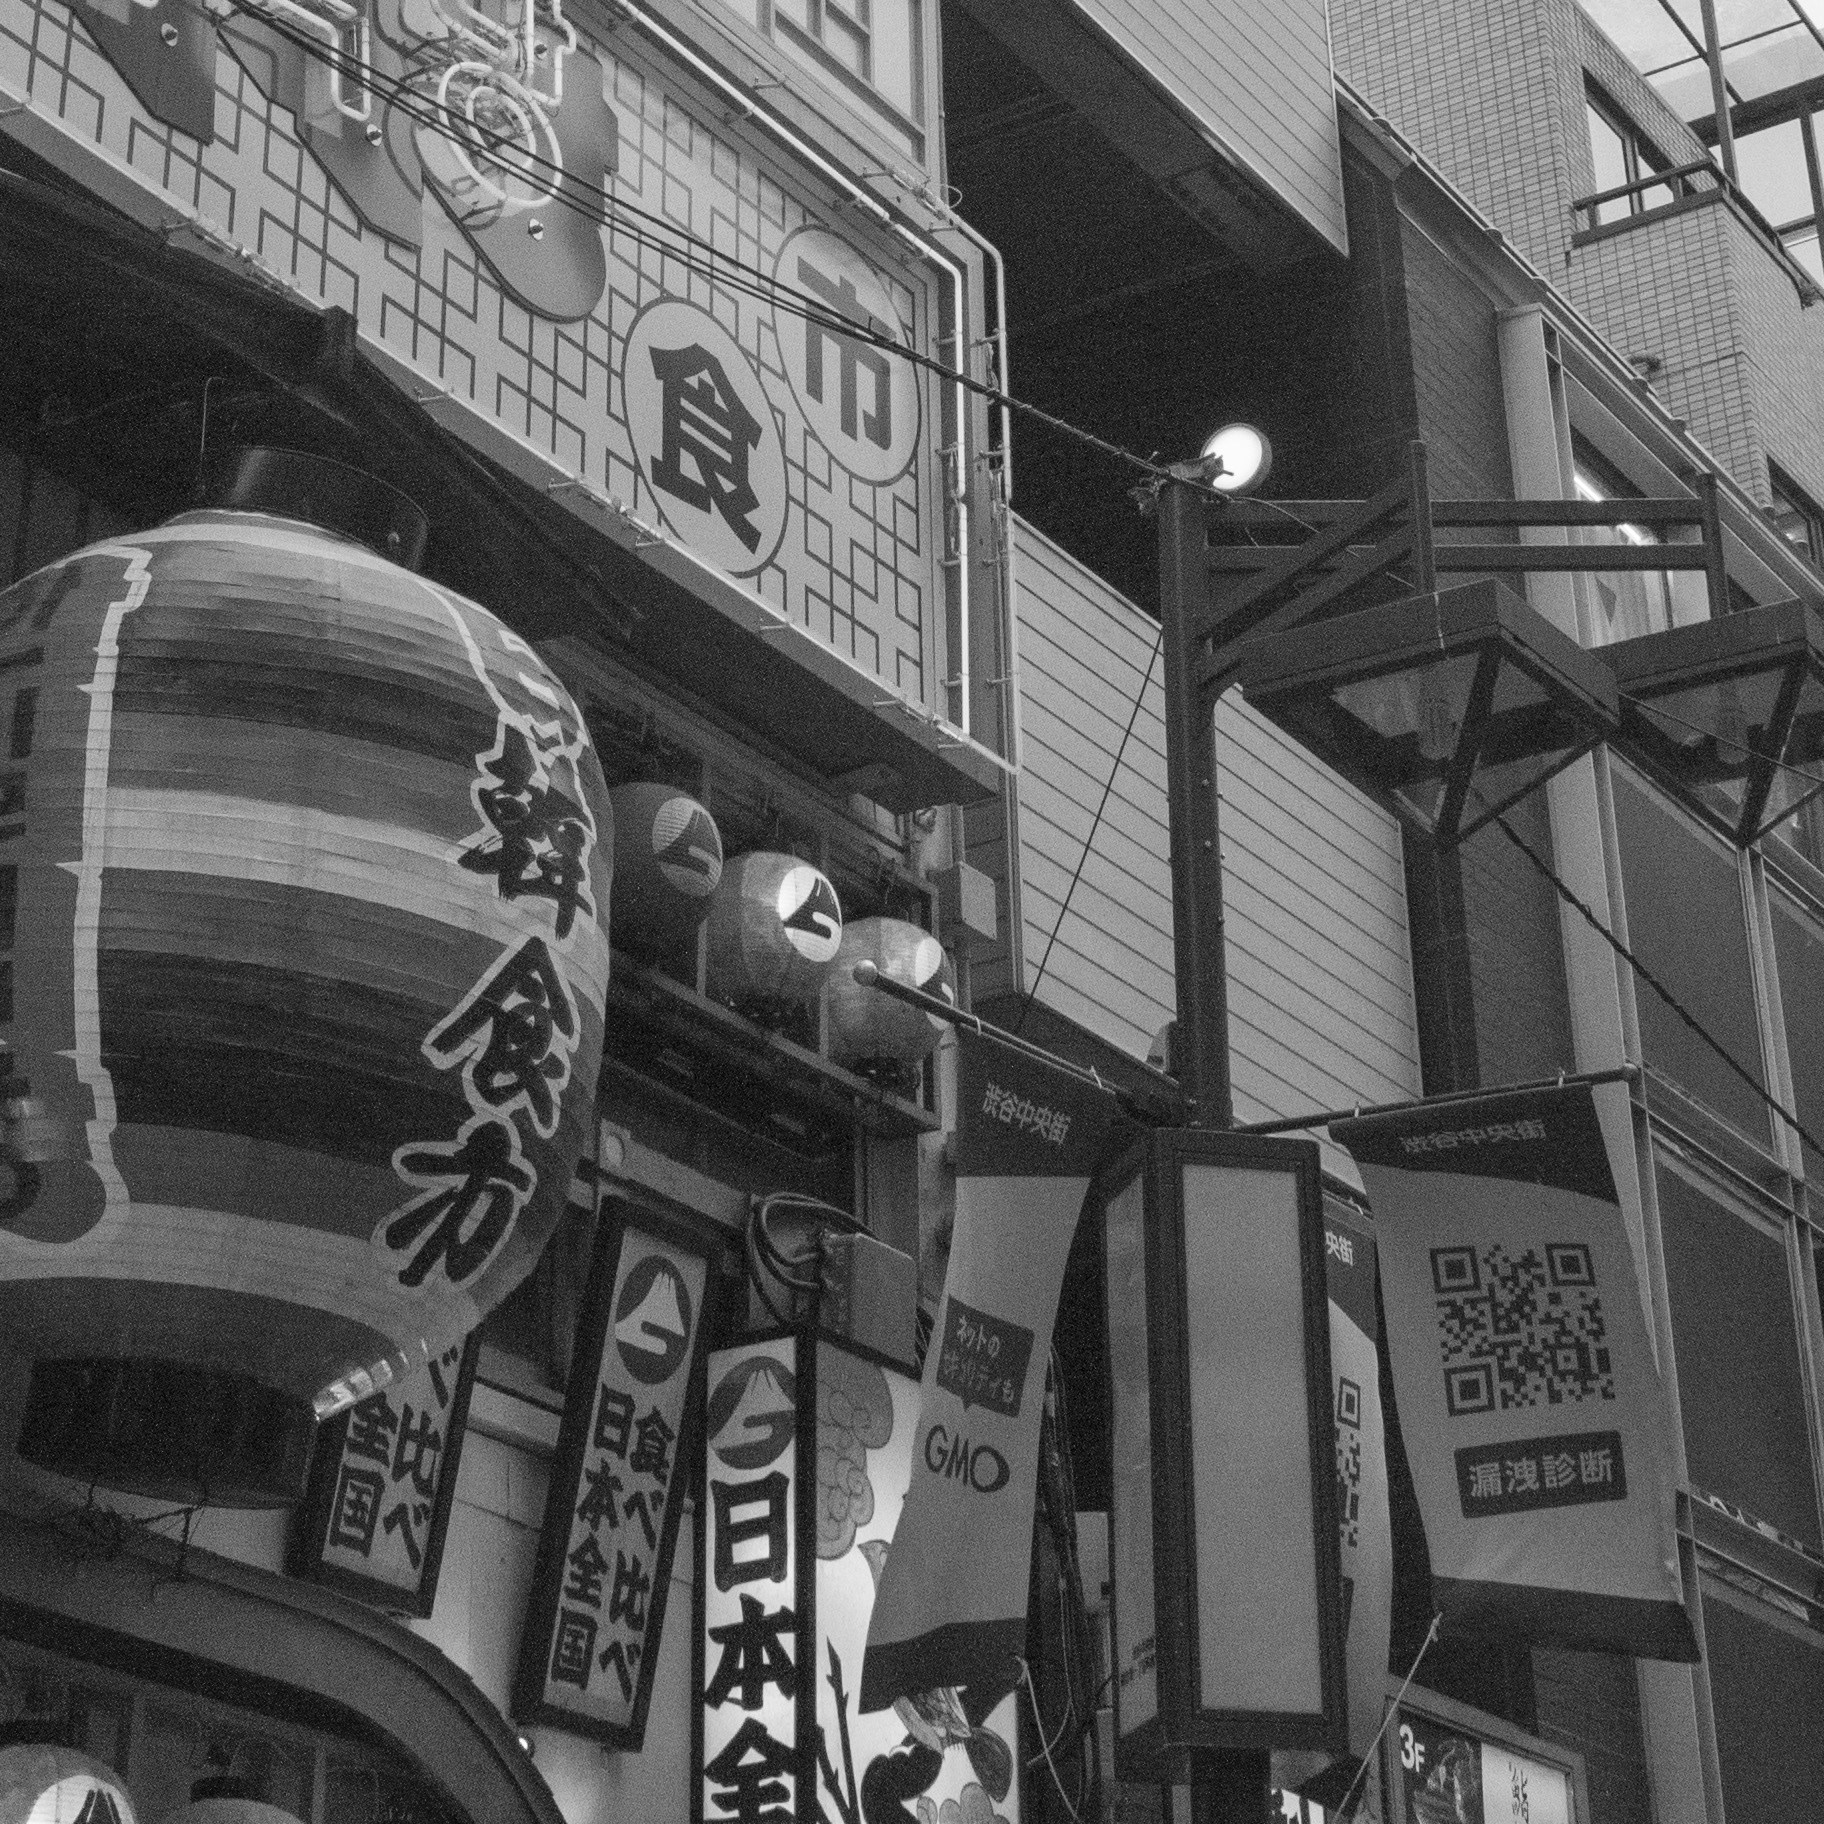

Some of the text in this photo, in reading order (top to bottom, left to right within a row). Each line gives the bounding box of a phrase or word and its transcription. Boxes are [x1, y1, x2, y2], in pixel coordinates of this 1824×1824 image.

[980, 1082, 1072, 1145] 渋谷中央街
[1400, 1117, 1547, 1154] 渋谷中央街
[924, 1423, 1011, 1494] GMO
[1466, 1446, 1615, 1501] 漏洩診断
[550, 1389, 636, 1688] 日本全国
[597, 1407, 677, 1704] 食べ比べ
[1398, 1723, 1426, 1774] 3F
